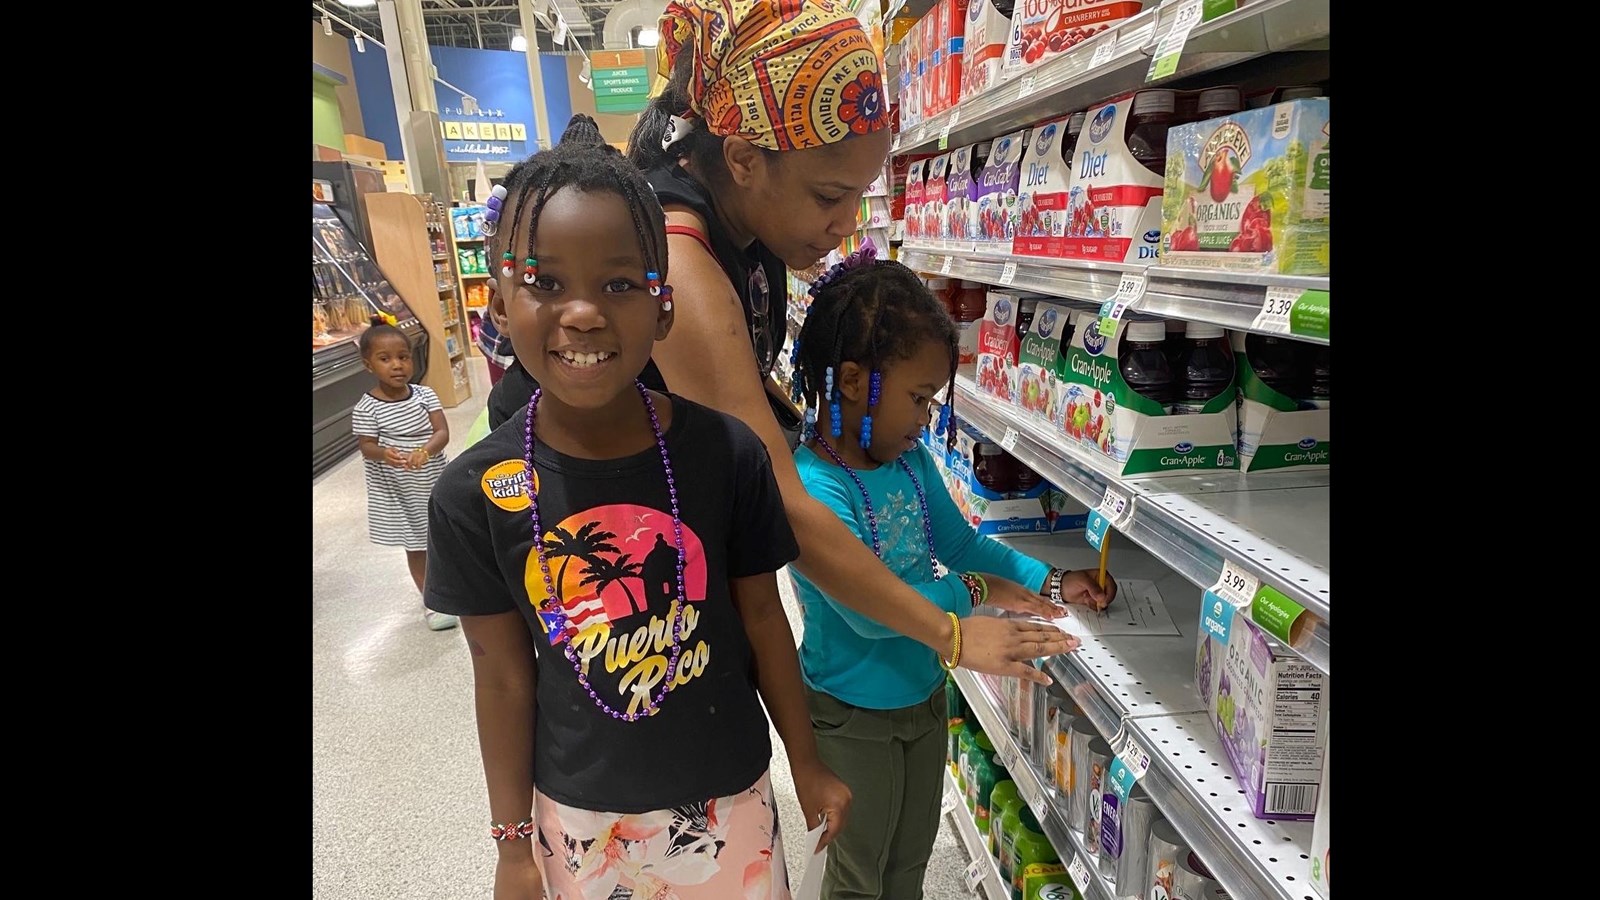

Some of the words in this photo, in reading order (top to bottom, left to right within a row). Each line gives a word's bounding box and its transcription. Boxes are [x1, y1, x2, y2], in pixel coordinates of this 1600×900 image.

[1064, 11, 1101, 25] CRANBERRY
[1014, 25, 1020, 41] 6
[615, 53, 621, 66] 1
[1080, 148, 1108, 180] Diet
[1027, 162, 1050, 187] Diet
[1196, 202, 1242, 221] ORGANICS
[1138, 245, 1160, 259] Die
[1119, 281, 1135, 293] 3.99
[1266, 299, 1292, 315] 3.39
[485, 471, 527, 488] Terrifi
[492, 484, 520, 498] Kid!
[1224, 570, 1246, 591] 3.99
[1260, 596, 1269, 605] Our
[1268, 602, 1290, 619] Apologies
[1205, 616, 1226, 637] organic
[564, 599, 700, 685] Puerto
[1229, 644, 1263, 705] ORGANIC
[1310, 692, 1320, 700] 40
[1126, 740, 1138, 757] 4.29
[1110, 776, 1126, 797] organic
